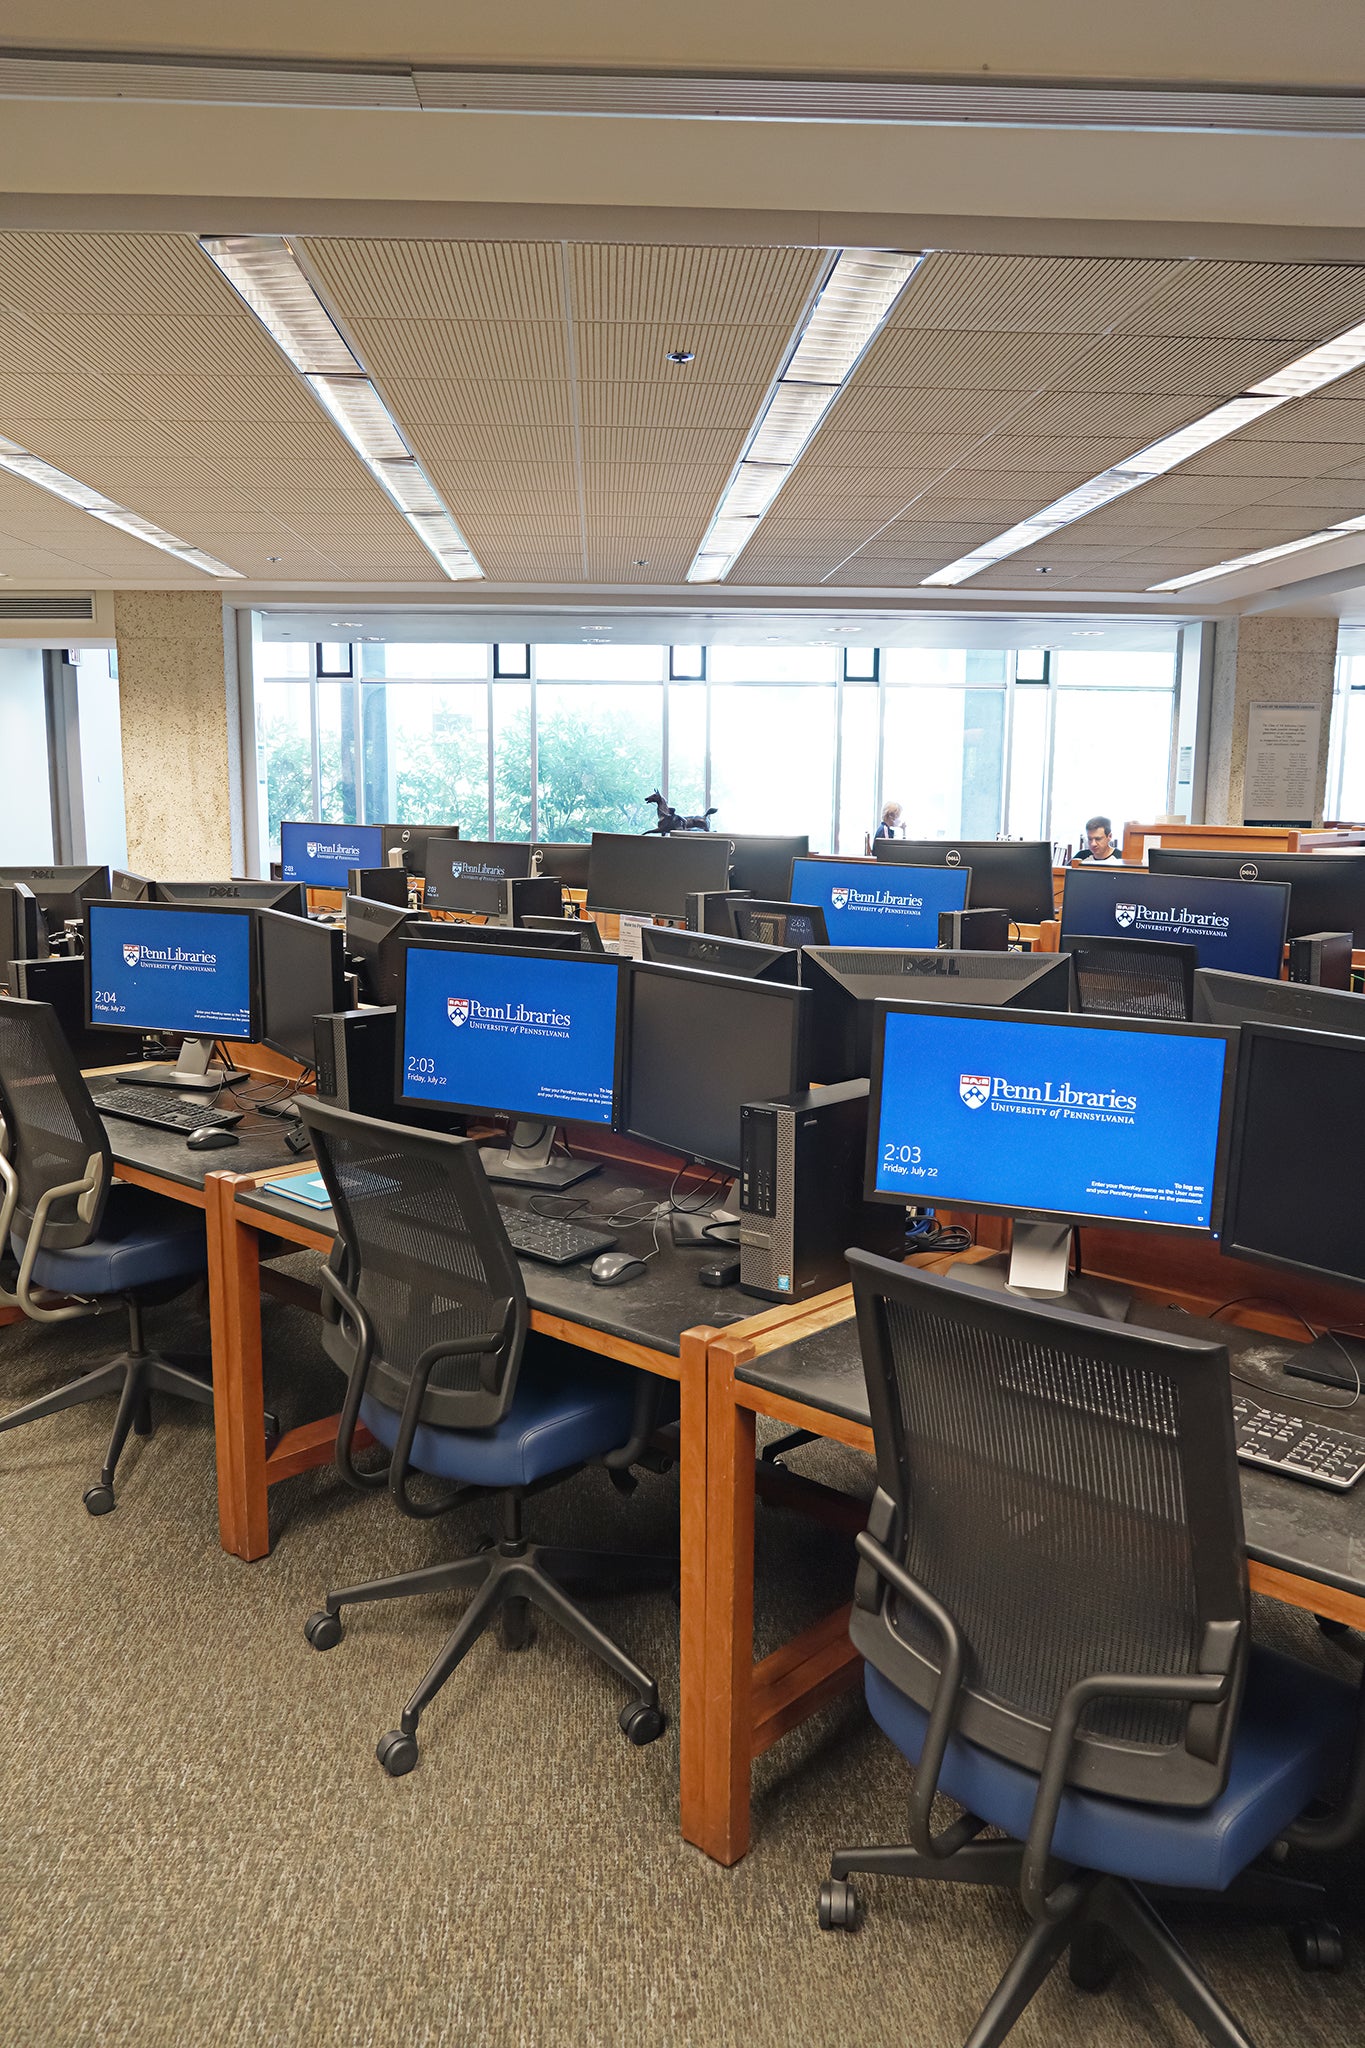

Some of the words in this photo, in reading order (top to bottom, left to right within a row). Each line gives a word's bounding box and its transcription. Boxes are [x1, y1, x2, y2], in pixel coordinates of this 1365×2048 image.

[317, 843, 332, 853] Penn
[333, 843, 360, 855] Libraries
[30, 870, 56, 879] DELL
[462, 862, 477, 873] Penn
[478, 863, 505, 875] Libraries
[208, 885, 240, 898] DELL
[849, 889, 875, 903] Penn
[875, 890, 923, 907] Libraries
[1136, 904, 1169, 921] Penn
[1169, 907, 1229, 927] Libraries
[1135, 922, 1172, 932] UNIVERSITY
[1173, 926, 1181, 934] of
[1182, 926, 1228, 937] PENNSYLVANIA
[140, 945, 167, 960] Penn
[167, 946, 217, 963] Libraries
[140, 961, 170, 969] UNIVERSITY
[170, 963, 178, 971] of
[178, 965, 217, 973] PENNSYLVANIA
[901, 957, 960, 976] DELL
[95, 990, 117, 1003] 2:04
[110, 1005, 120, 1013] July
[470, 1000, 505, 1020] Penn
[506, 1003, 571, 1026] Libraries
[469, 1020, 509, 1032] UNIVERSITY
[510, 1025, 519, 1034] of
[519, 1026, 570, 1039] PENNSYLVANIA
[408, 1056, 435, 1074] 2:03
[407, 1072, 426, 1083] Friday,
[427, 1075, 438, 1085] July
[439, 1076, 447, 1085] 22
[991, 1077, 1042, 1100] Penn
[1043, 1081, 1137, 1110] Libraries
[990, 1102, 1048, 1116] UNIVERSITY
[1049, 1108, 1062, 1119] of
[1063, 1109, 1135, 1125] PENNSYLVANIA
[884, 1143, 922, 1164] 2:03
[883, 1163, 909, 1176] Friday,
[910, 1165, 927, 1178] July
[927, 1167, 938, 1177] 22
[1109, 1189, 1133, 1198] PennKey
[1133, 1192, 1159, 1200] password
[1118, 1184, 1142, 1192] PennKey
[1183, 1183, 1194, 1191] log
